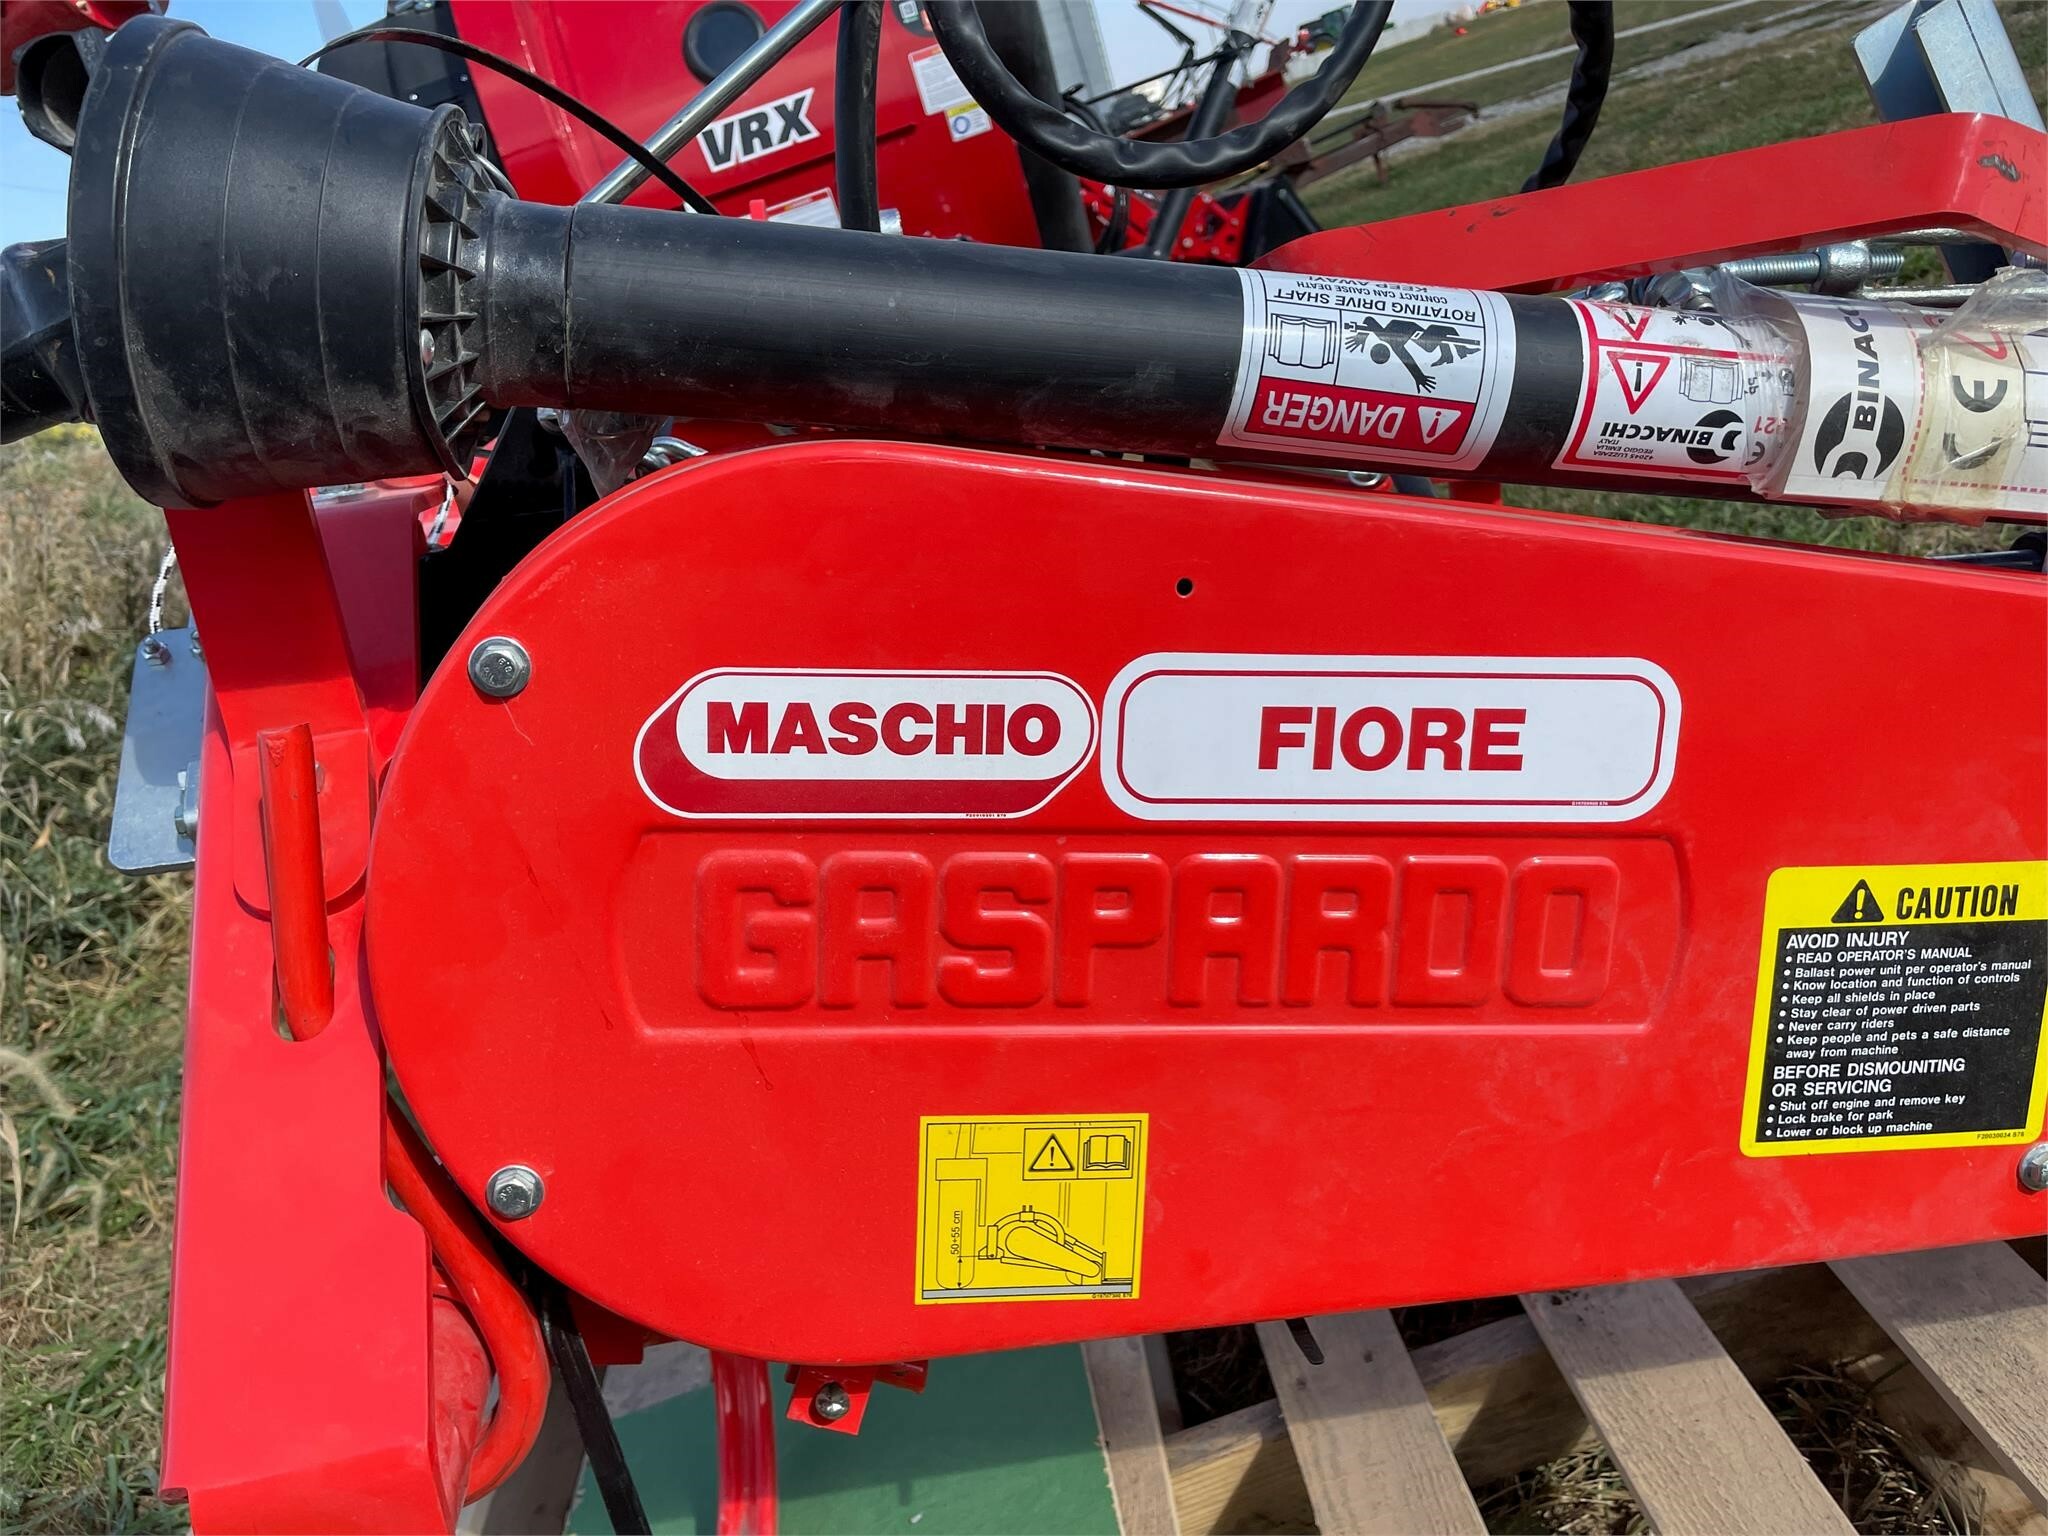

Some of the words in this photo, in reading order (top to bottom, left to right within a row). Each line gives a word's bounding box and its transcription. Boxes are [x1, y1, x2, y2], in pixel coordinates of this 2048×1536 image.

[702, 96, 811, 166] VRX
[1296, 281, 1331, 291] DEATH
[1334, 284, 1371, 296] CAUSE
[1373, 289, 1396, 299] CAN
[1273, 288, 1330, 304] SHAFT
[1335, 295, 1386, 311] DRIVE
[1399, 292, 1448, 304] CONTACT
[1391, 302, 1476, 322] ROTATING
[1262, 390, 1406, 439] DANGER
[1600, 421, 1714, 446] BINACCHI
[1596, 444, 1622, 452] EMILIA
[1598, 438, 1619, 446] ITALY
[1623, 445, 1654, 454] REGGIO
[1593, 450, 1628, 458] LUZZARA
[707, 701, 1061, 756] MASCHIO
[1257, 705, 1527, 771] FIORE
[1896, 885, 2018, 920] CAUTION
[696, 850, 1619, 1010] GASPARDO
[1786, 934, 1839, 949] AVOID
[1847, 931, 1909, 947] INJURY
[1797, 952, 1832, 963] READ
[1837, 949, 1916, 962] OPERATOR'S
[1921, 947, 1972, 959] MANUAL
[1795, 968, 1835, 978] Ballast
[1840, 968, 1876, 978] power
[1880, 965, 1901, 975] unit
[1906, 966, 1925, 976] per
[1930, 962, 1986, 974] operator's
[1992, 960, 2031, 970] manual
[1794, 981, 1826, 990] Know
[1830, 978, 1876, 989] location
[1882, 977, 1903, 987] and
[1908, 976, 1953, 986] function
[1958, 974, 1970, 984] of
[1974, 973, 2020, 983] controls
[1792, 995, 1822, 1005] Keep
[1827, 993, 1840, 1003] all
[1845, 992, 1885, 1002] shields
[1890, 991, 1900, 1000] in
[1904, 990, 1935, 1002] place
[1791, 1008, 1818, 1019] Stay
[1822, 1007, 1851, 1017] clear
[1856, 1006, 1868, 1015] of
[1872, 1006, 1908, 1016] power
[1912, 1004, 1946, 1013] driven
[1951, 1002, 1980, 1014] parts
[1789, 1022, 1822, 1031] Never
[1827, 1022, 1857, 1031] carry
[1862, 1019, 1894, 1028] riders
[1788, 1035, 1817, 1046] Keep
[1822, 1033, 1861, 1045] people
[1866, 1031, 1887, 1041] and
[1892, 1031, 1917, 1042] pets
[1934, 1028, 1958, 1038] safe
[1963, 1028, 2010, 1037] distance
[1786, 1050, 1816, 1059] away
[1821, 1048, 1846, 1057] from
[1852, 1045, 1898, 1056] machine
[1774, 1064, 1841, 1079] BEFORE
[1848, 1058, 1965, 1076] DISMOUNITING
[1772, 1083, 1796, 1097] OR
[1804, 1079, 1891, 1096] SERVICING
[1780, 1101, 1806, 1111] Shut
[1811, 1100, 1828, 1110] off
[1832, 1099, 1870, 1110] engine
[1874, 1097, 1896, 1107] and
[1900, 1097, 1940, 1106] remove
[1945, 1094, 1965, 1104] key
[1778, 1114, 1806, 1124] Lock
[1811, 1112, 1843, 1122] brake
[1848, 1112, 1864, 1121] for
[1868, 1110, 1893, 1122] park
[1777, 1128, 1811, 1137] Lower
[1832, 1124, 1863, 1134] block
[1868, 1126, 1882, 1134] up
[1886, 1122, 1932, 1132] machine
[953, 1210, 960, 1222] cm
